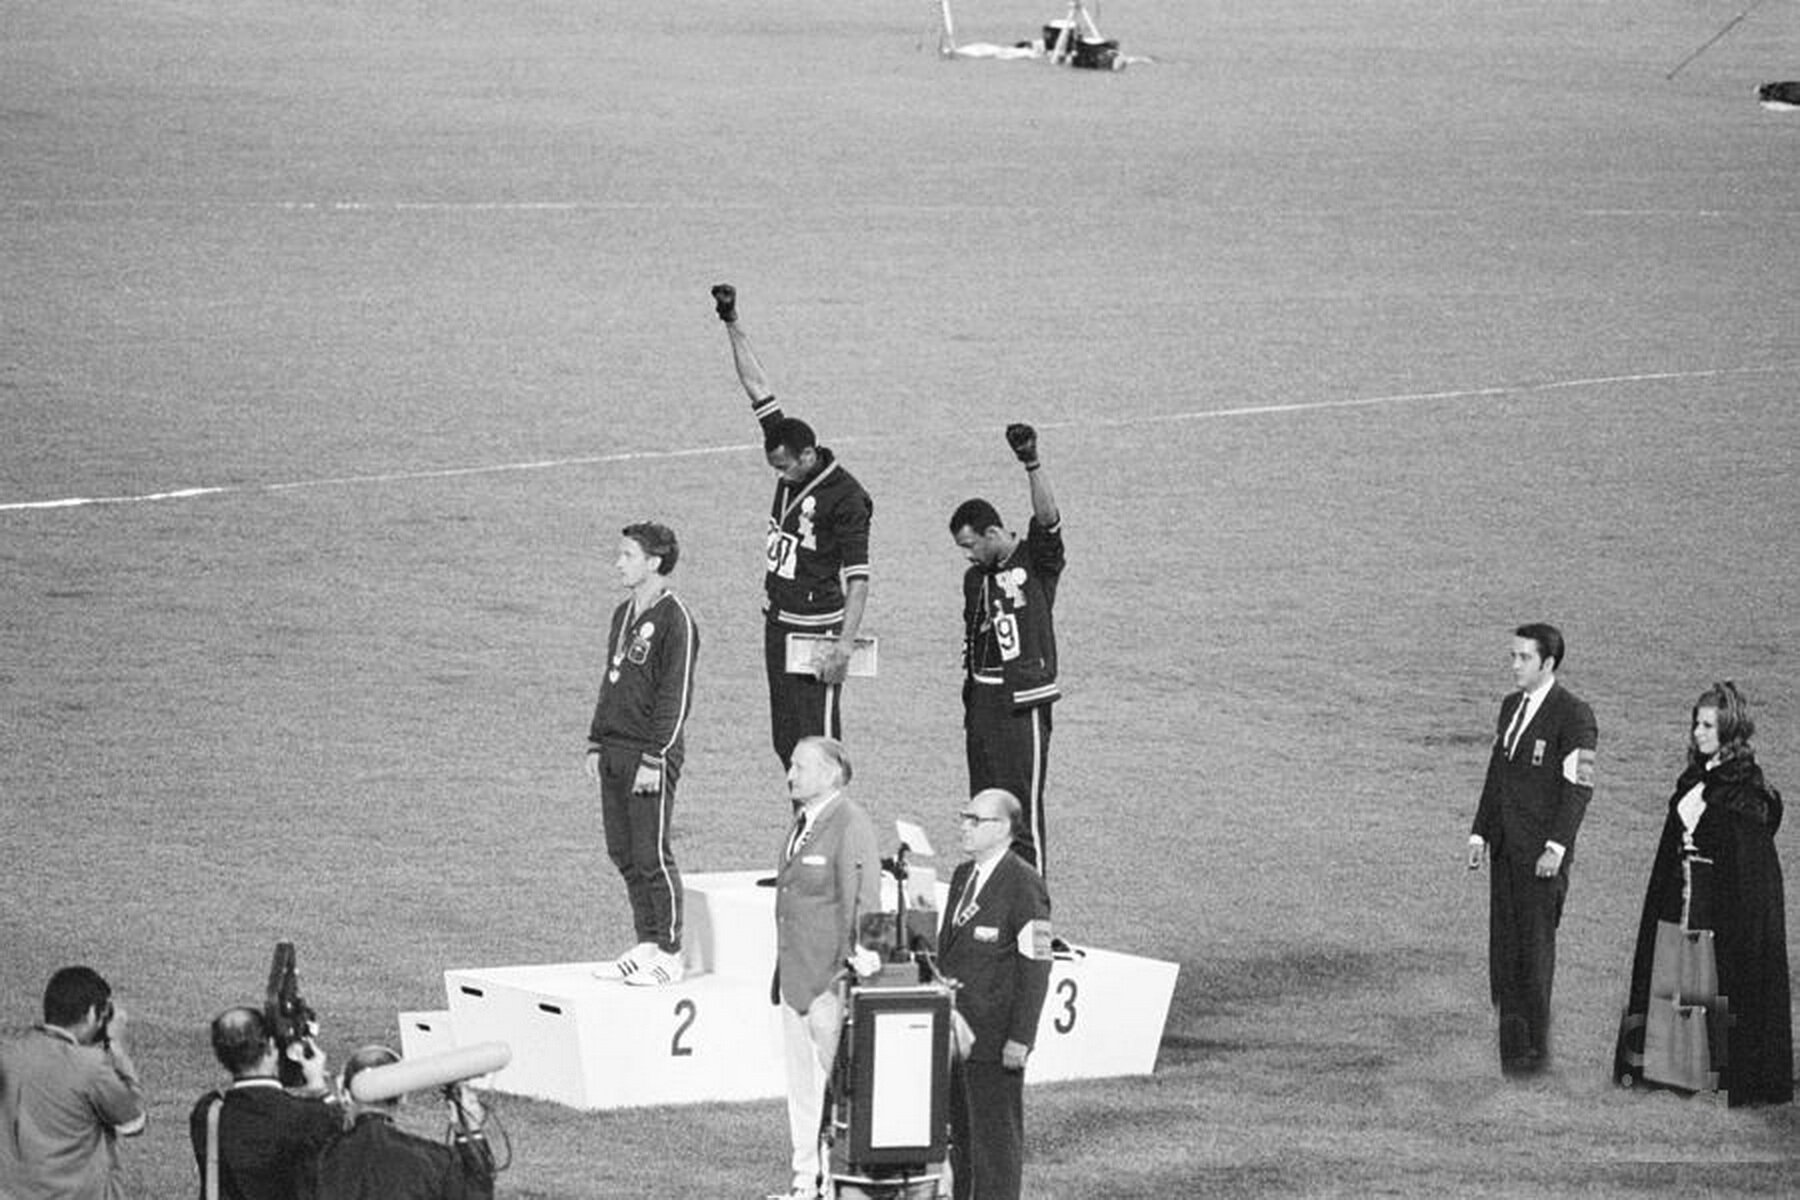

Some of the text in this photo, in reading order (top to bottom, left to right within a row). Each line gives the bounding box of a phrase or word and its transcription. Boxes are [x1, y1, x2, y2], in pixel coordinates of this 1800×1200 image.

[998, 619, 1014, 650] 9
[671, 998, 697, 1057] 2
[1054, 978, 1078, 1034] 3
